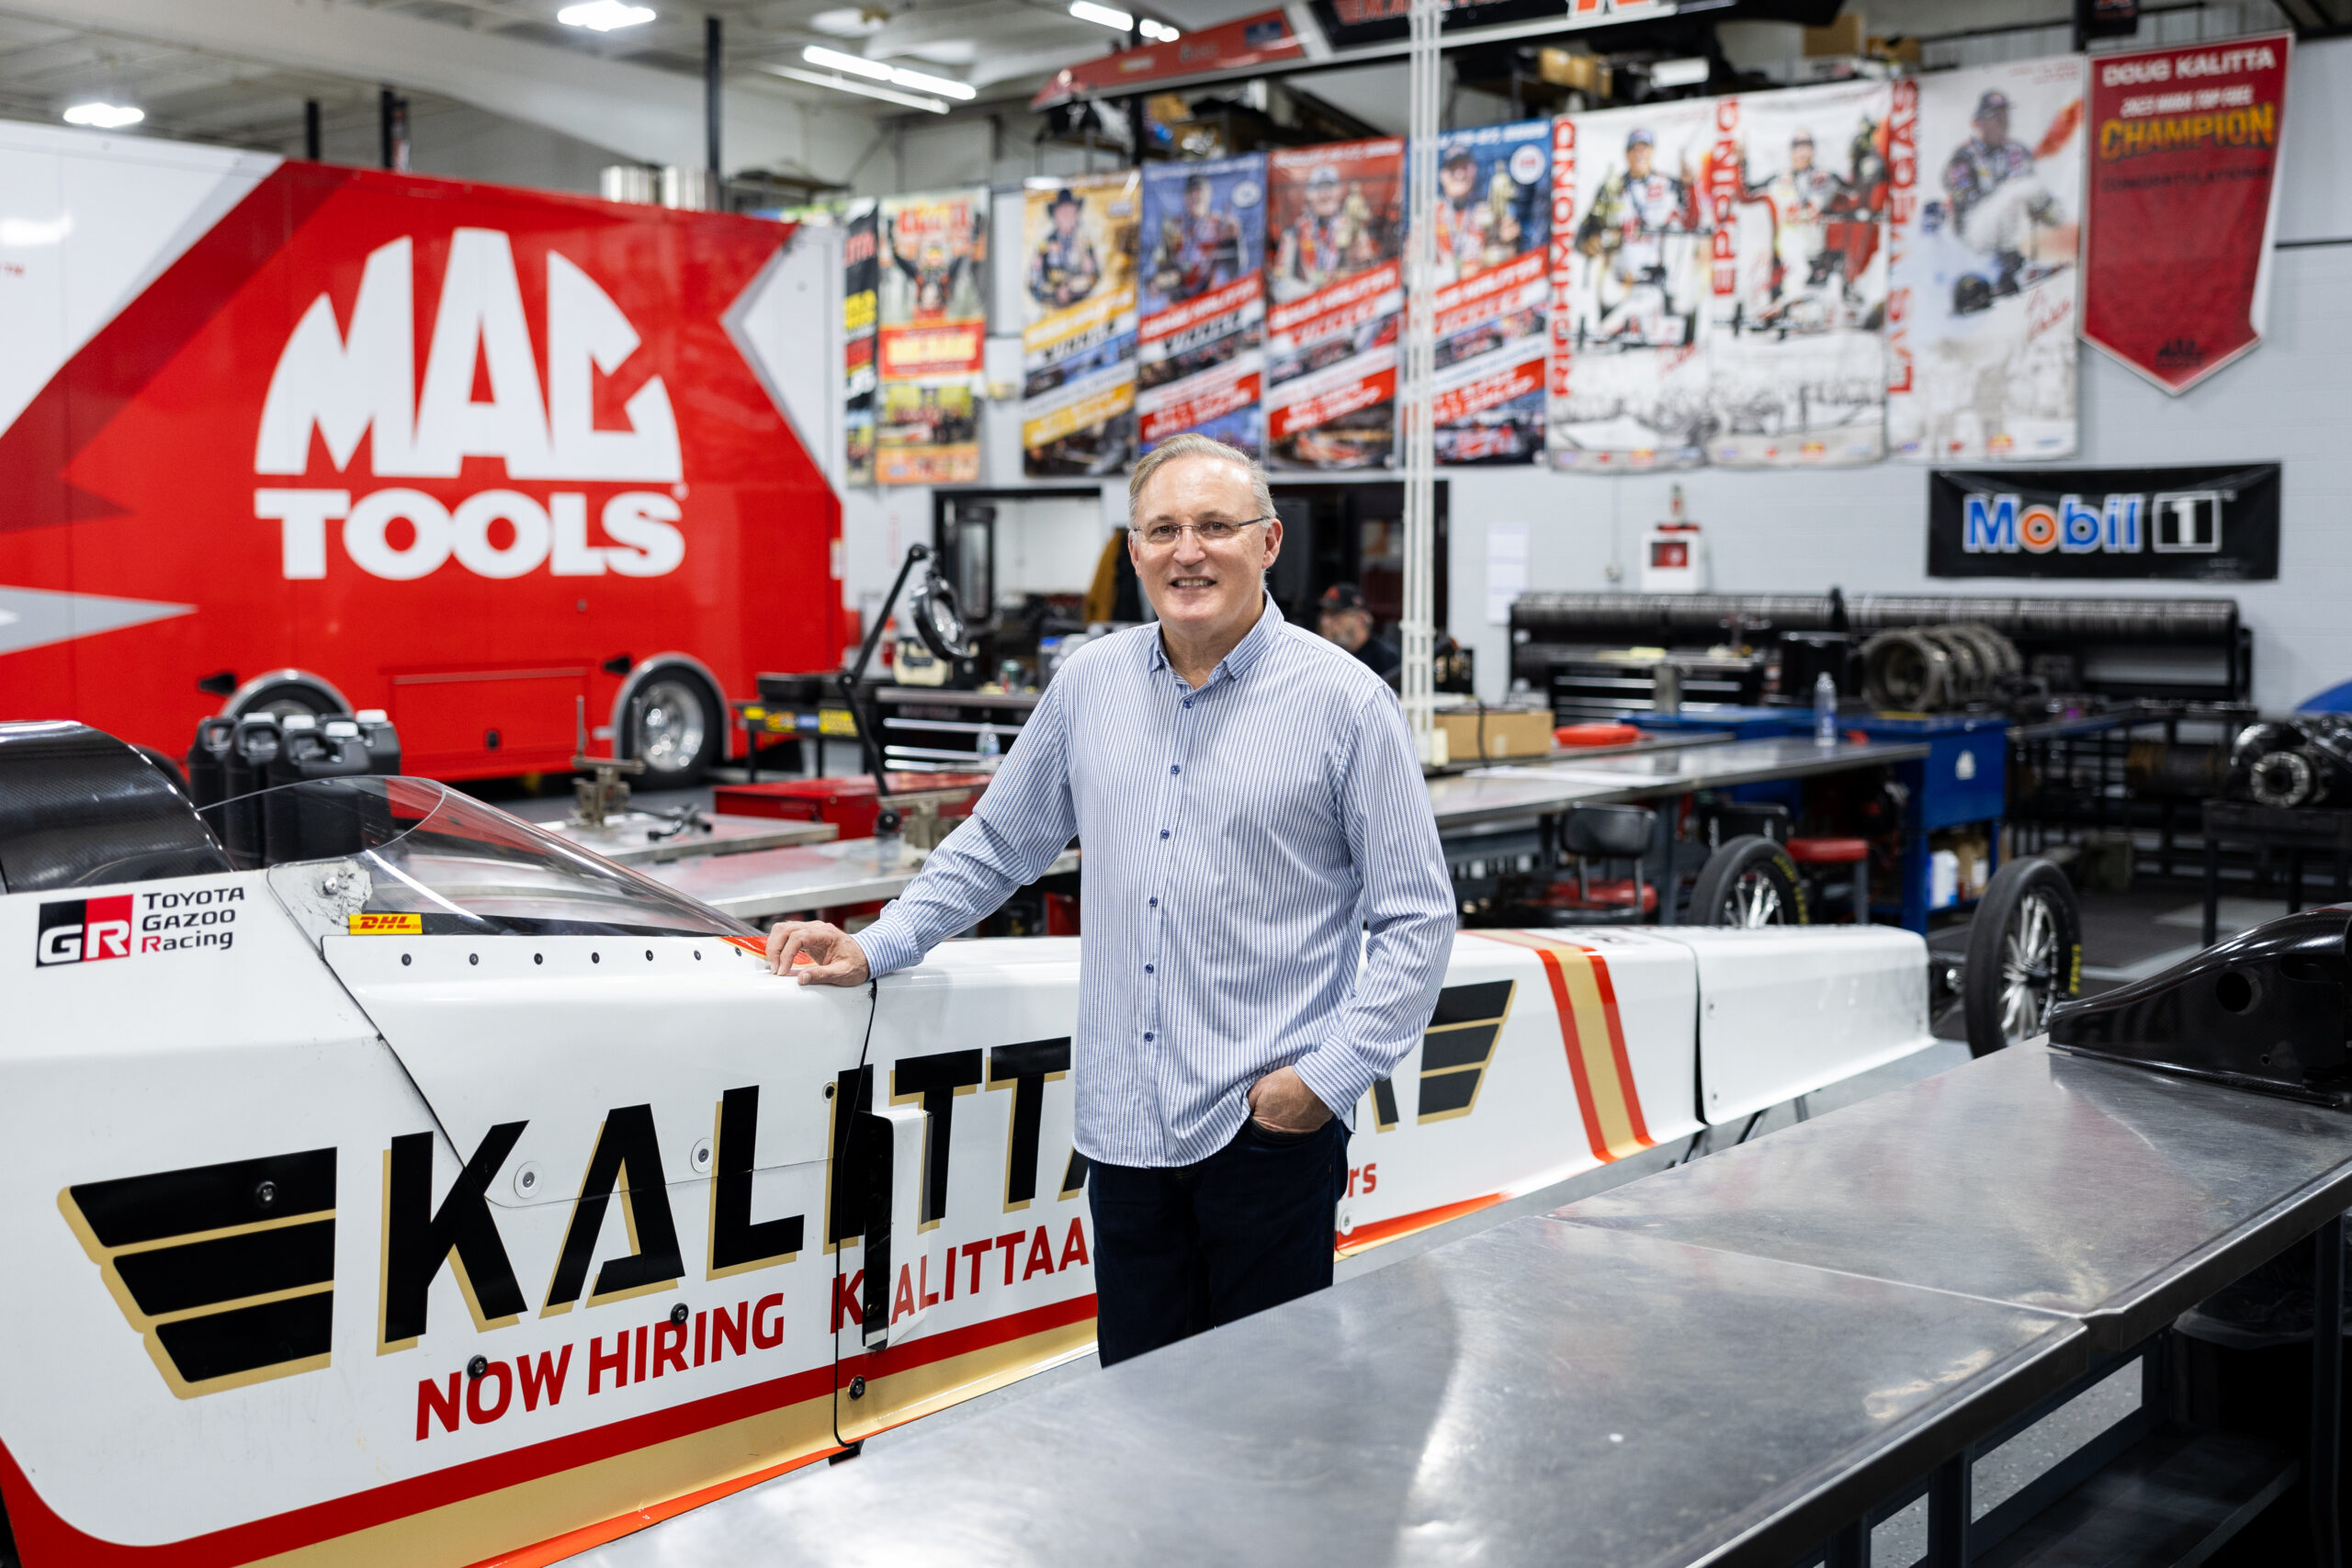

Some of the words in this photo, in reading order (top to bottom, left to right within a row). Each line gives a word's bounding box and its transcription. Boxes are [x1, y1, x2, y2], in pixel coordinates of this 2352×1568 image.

[2102, 58, 2172, 87] DOUG
[2175, 46, 2276, 79] KALITTA
[2099, 102, 2275, 162] CHAMPION
[1712, 97, 1739, 295] EPPING
[1551, 118, 1575, 396] RICHMOND
[254, 227, 684, 484] MAC
[254, 488, 686, 581] TOOLS
[1962, 493, 2146, 553] Mobil
[38, 919, 130, 964] GR
[141, 908, 236, 932] GAZOO
[141, 930, 233, 953] Racing
[359, 916, 415, 930] DHL
[378, 1037, 1090, 1355] KALITT
[416, 1344, 572, 1440] NOW
[588, 1292, 785, 1395] HIRING
[1340, 1163, 1376, 1201] rs
